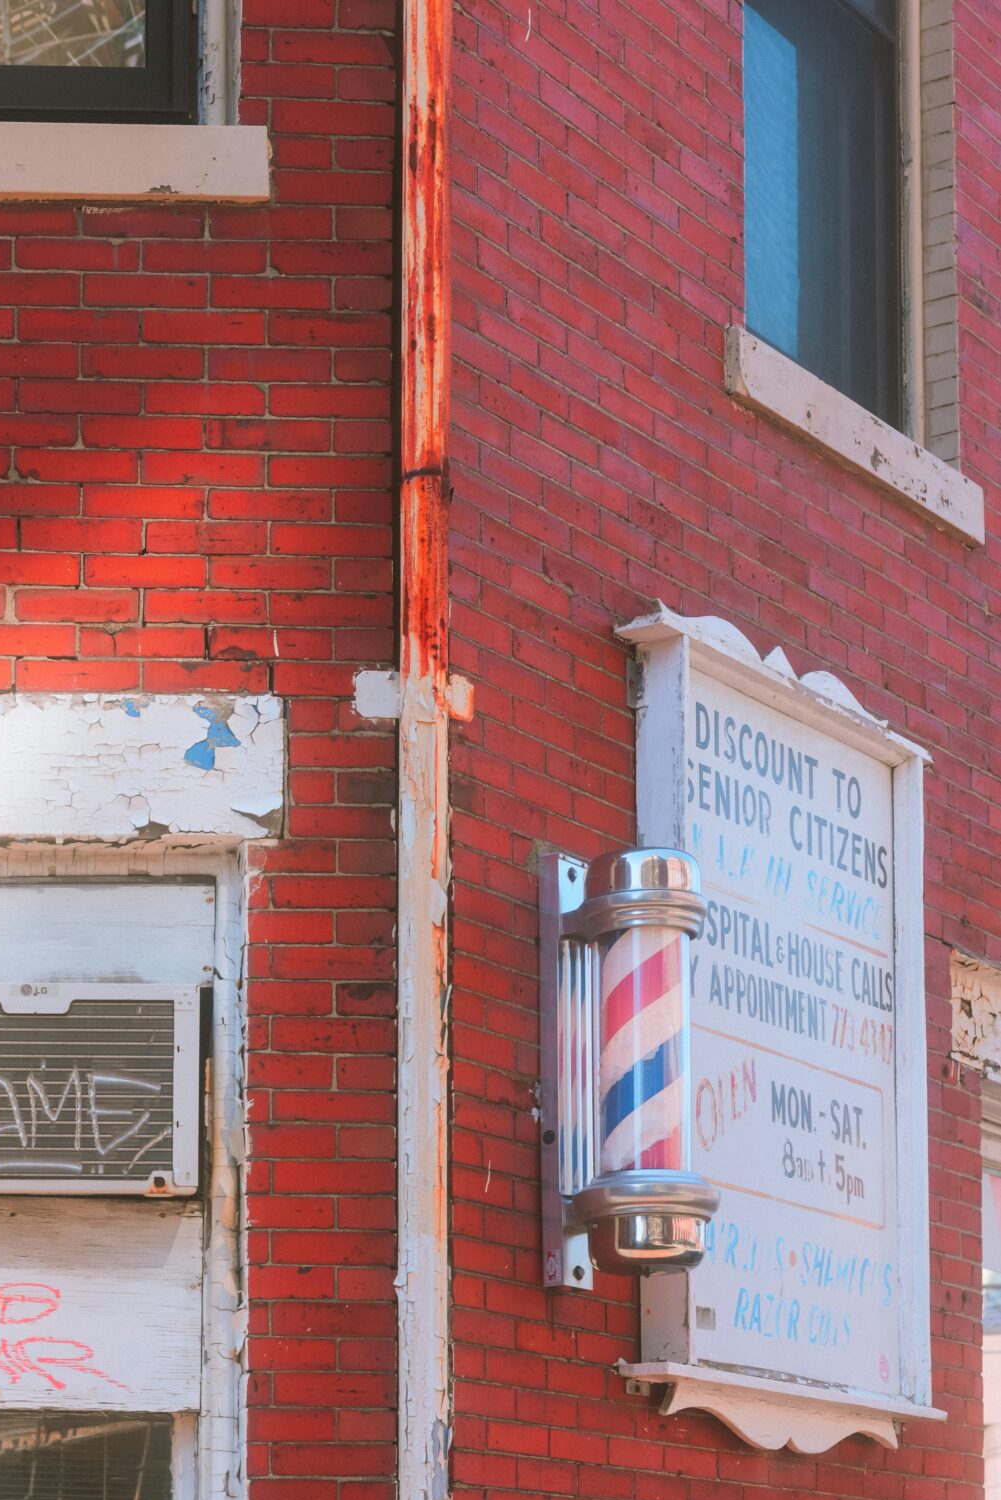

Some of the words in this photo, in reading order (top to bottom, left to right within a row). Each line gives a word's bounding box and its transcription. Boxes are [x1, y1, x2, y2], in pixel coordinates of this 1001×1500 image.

[695, 701, 819, 800] DISCOUNT
[832, 767, 862, 819] TO
[790, 805, 888, 889] CITIZENS
[697, 900, 774, 968] SPITAL
[788, 931, 844, 993] HOUSE
[851, 957, 893, 1012] CALLS
[709, 961, 828, 1042] APPOINTMENT
[696, 1056, 758, 1152] OPEN
[835, 1154, 866, 1205] 5pm
